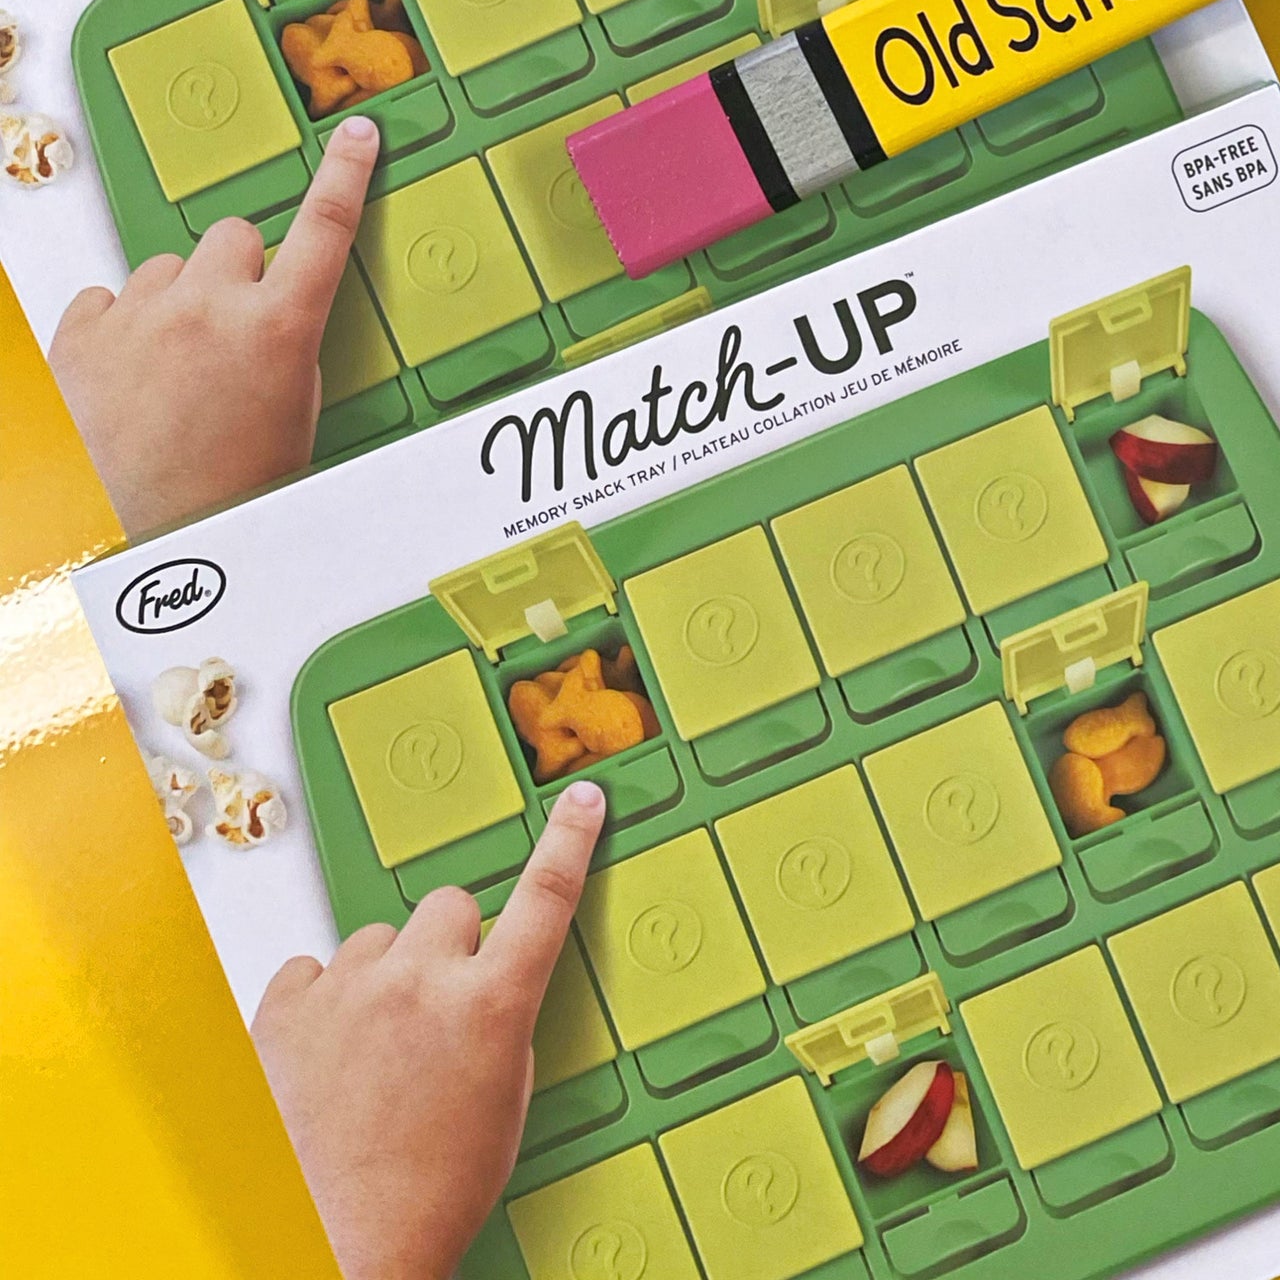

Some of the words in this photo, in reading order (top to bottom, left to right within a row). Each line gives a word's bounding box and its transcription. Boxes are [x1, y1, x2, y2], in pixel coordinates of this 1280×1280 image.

[1183, 136, 1259, 179] BPA-FREE
[1192, 172, 1234, 200] SANS
[1235, 159, 1268, 183] BPA
[504, 502, 566, 538] MEMORY
[573, 480, 625, 509] SNACK
[627, 462, 664, 486] TRAY
[682, 428, 749, 464] PLATEAU
[754, 392, 835, 434] COLLATION
[841, 379, 867, 399] JEU
[871, 369, 891, 385] DE
[895, 340, 962, 375] MÉMOIRE
[138, 567, 204, 625] Fred
